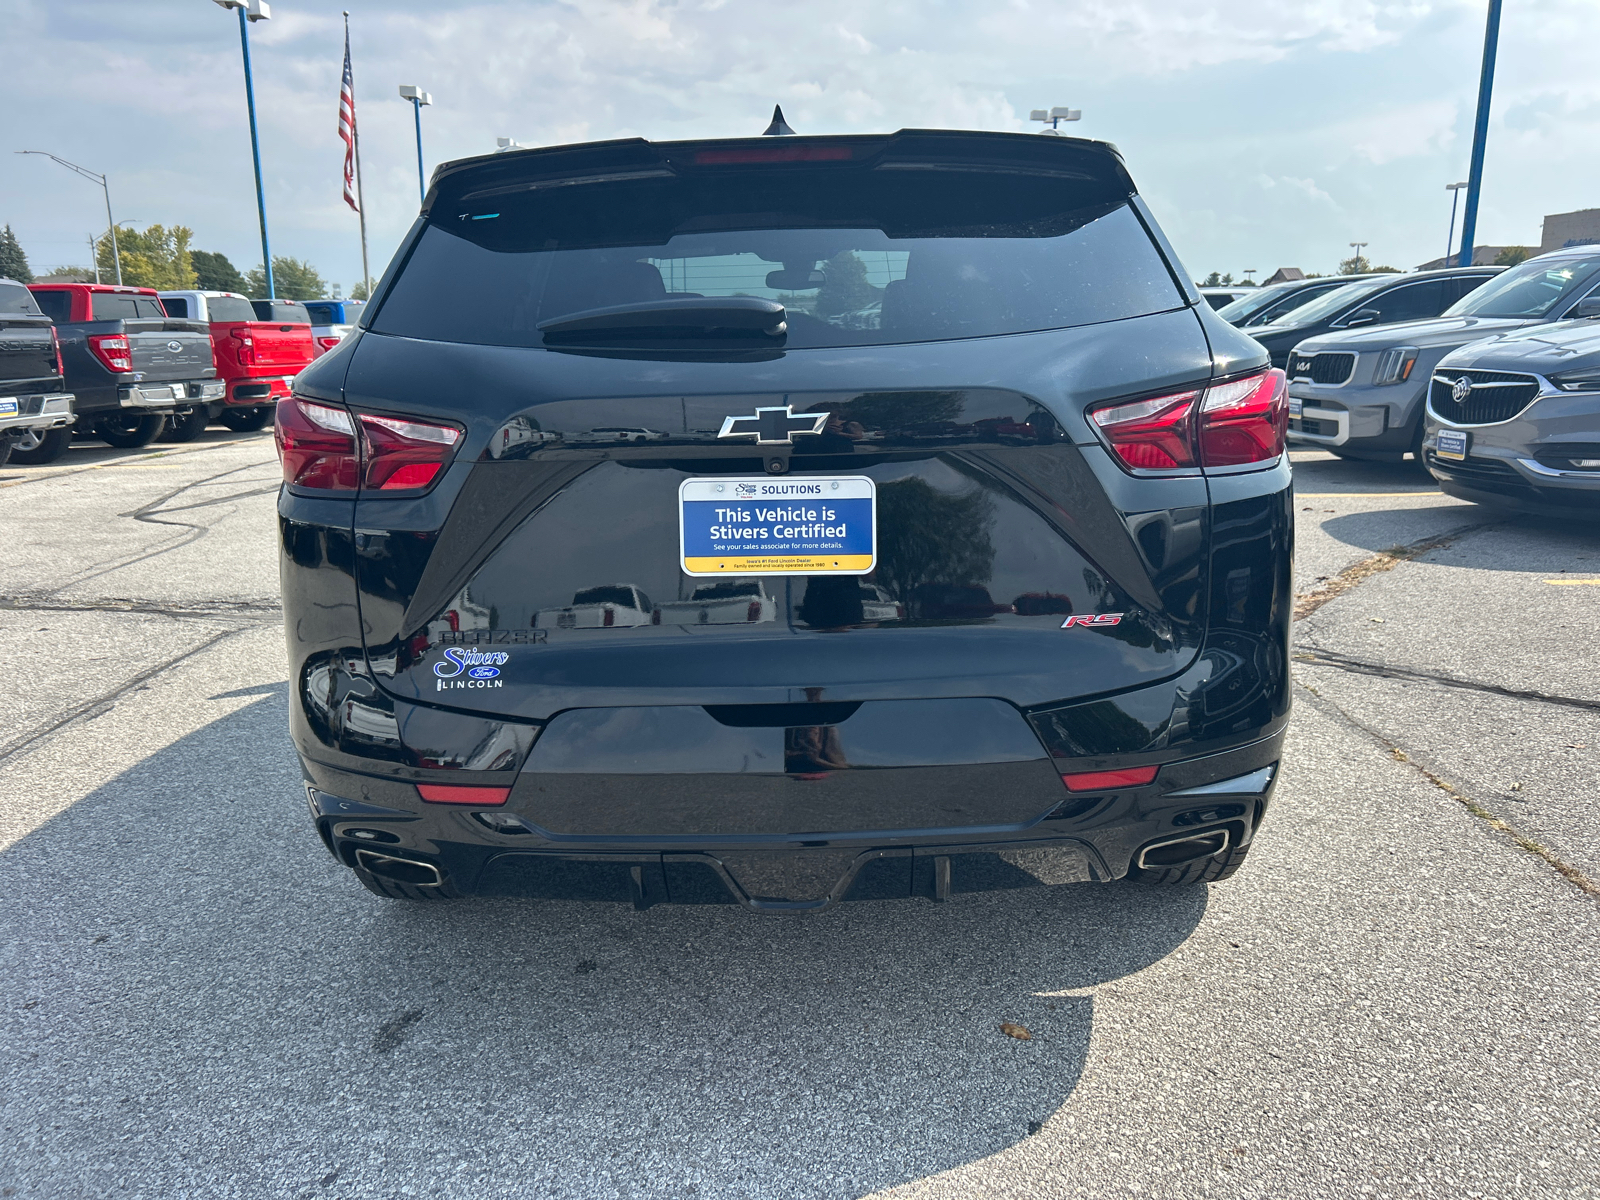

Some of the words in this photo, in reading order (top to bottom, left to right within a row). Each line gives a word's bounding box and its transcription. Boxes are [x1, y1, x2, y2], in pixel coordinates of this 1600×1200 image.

[761, 485, 821, 495] SOLUTIONS
[715, 508, 751, 523] This
[755, 508, 817, 522] Vehicle
[822, 506, 836, 521] is
[709, 525, 769, 540] Stivers
[773, 523, 847, 539] Certified
[713, 543, 726, 551] See
[727, 543, 741, 551] your
[760, 542, 790, 550] associate
[820, 541, 844, 549] details.
[1060, 612, 1125, 629] RS
[438, 629, 548, 645] BLAZER
[433, 646, 510, 678] Stivers
[474, 668, 494, 677] Ford
[442, 679, 503, 689] LINCOLN
